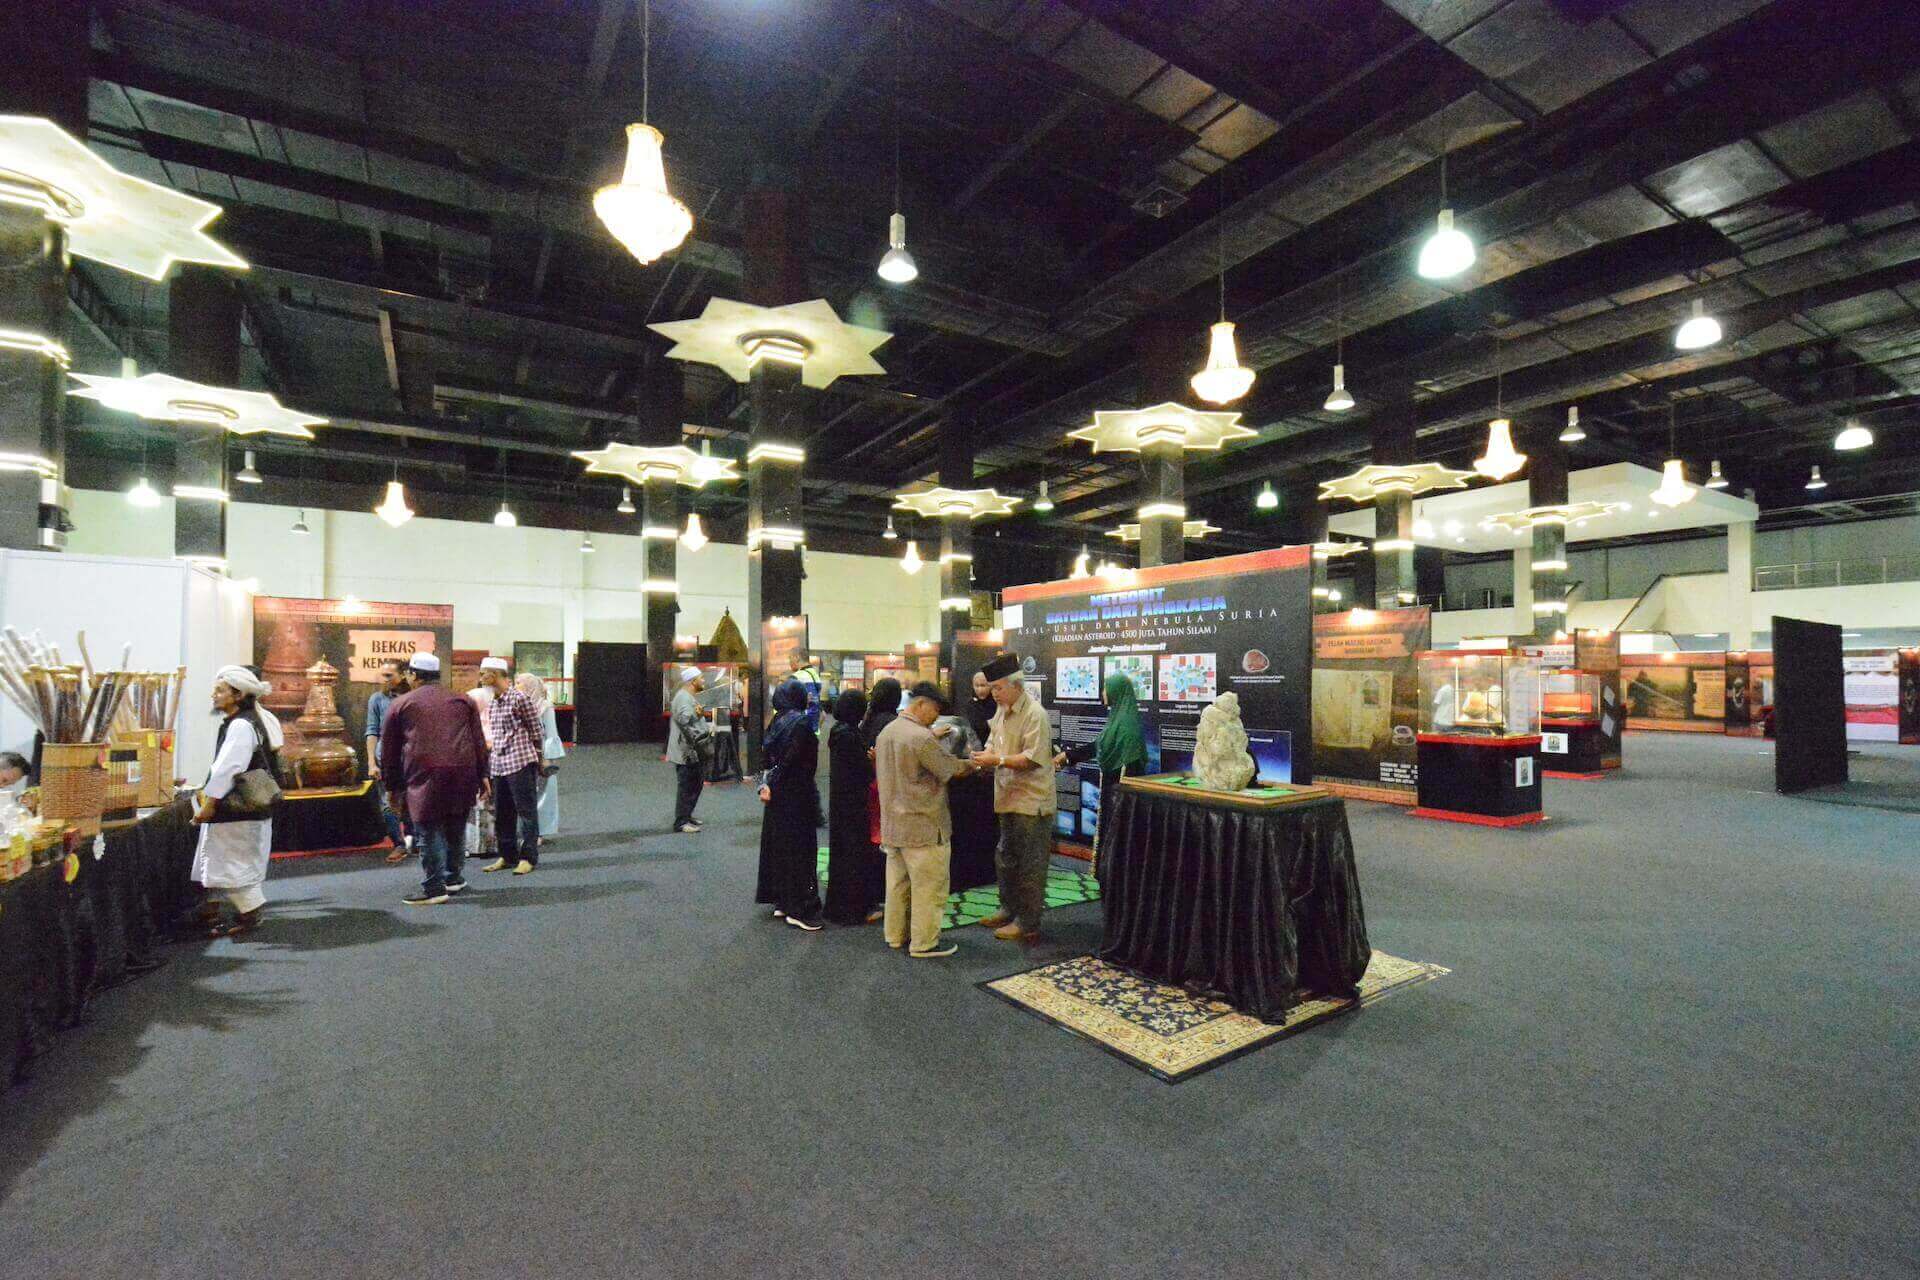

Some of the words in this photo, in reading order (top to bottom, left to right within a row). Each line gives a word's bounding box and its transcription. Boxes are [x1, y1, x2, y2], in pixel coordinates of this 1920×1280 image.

[1095, 619, 1129, 630] DARI
[1141, 615, 1204, 626] NEBULA
[1219, 608, 1278, 621] SURIA
[1084, 631, 1116, 640] ASTEROID
[1121, 630, 1137, 639] 4500
[1139, 629, 1155, 639] JUTA
[1158, 627, 1184, 636] TAHUN
[1187, 625, 1212, 635] SILAM
[372, 640, 416, 653] BEKAS
